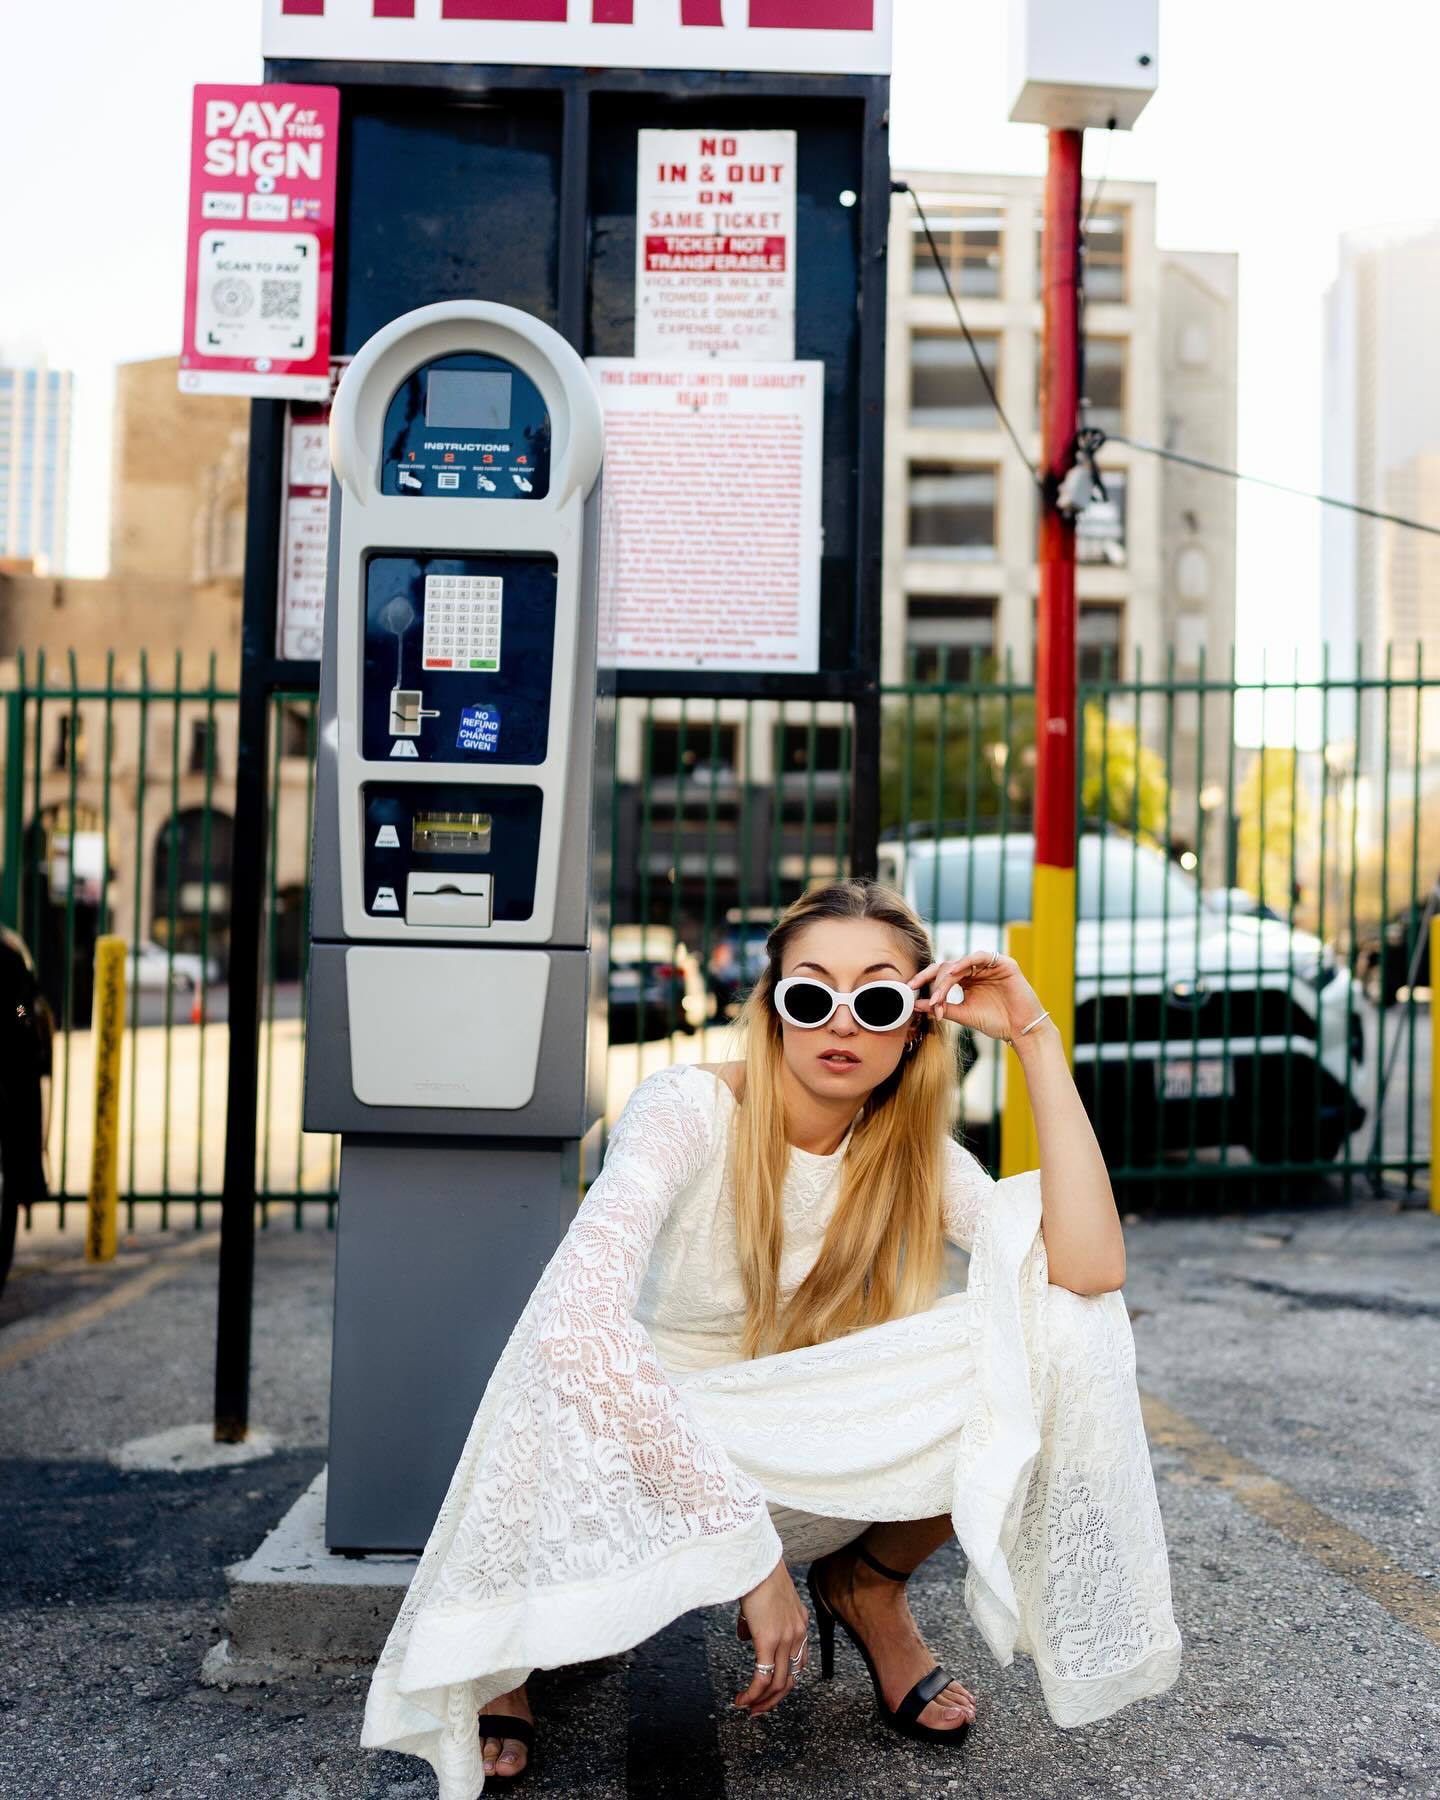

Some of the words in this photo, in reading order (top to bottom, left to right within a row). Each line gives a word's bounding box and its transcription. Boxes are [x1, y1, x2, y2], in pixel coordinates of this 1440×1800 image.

[205, 100, 295, 138] PAY
[294, 110, 317, 123] AT
[287, 124, 324, 138] THIS
[700, 139, 737, 156] NO
[204, 139, 322, 179] SIGN
[659, 164, 687, 182] IN
[700, 165, 714, 182] &
[728, 165, 783, 182] OUT
[699, 192, 733, 204] ON
[651, 212, 703, 228] SAME
[713, 213, 780, 228] TICKET
[665, 238, 725, 253] TICKET
[730, 238, 765, 253] NOT
[216, 262, 250, 271] SCAN
[256, 263, 271, 271] TO
[276, 264, 299, 272] PAY
[649, 254, 783, 269] TRANSFERABLE
[646, 278, 721, 286] VIOLATORS
[729, 278, 760, 286] WILL
[768, 278, 784, 287] BE
[659, 293, 707, 302] TOWED
[716, 293, 749, 302] AWAY
[757, 293, 769, 302] AT
[654, 309, 708, 317] VEHICLE
[601, 372, 623, 385] THIS
[629, 372, 683, 385] CONTRACT
[687, 374, 724, 386] LIMITS
[729, 375, 748, 386] OUR
[753, 375, 805, 387] LIABILITY
[677, 392, 708, 405] READ
[424, 443, 509, 451] INSTRUCTIONS
[409, 452, 415, 461] 1
[444, 453, 454, 462] 2
[483, 454, 493, 463] 3
[517, 456, 527, 464] 4
[463, 718, 498, 729] REFUND
[460, 730, 496, 742] CHANGE
[464, 740, 491, 750] GIVEN
